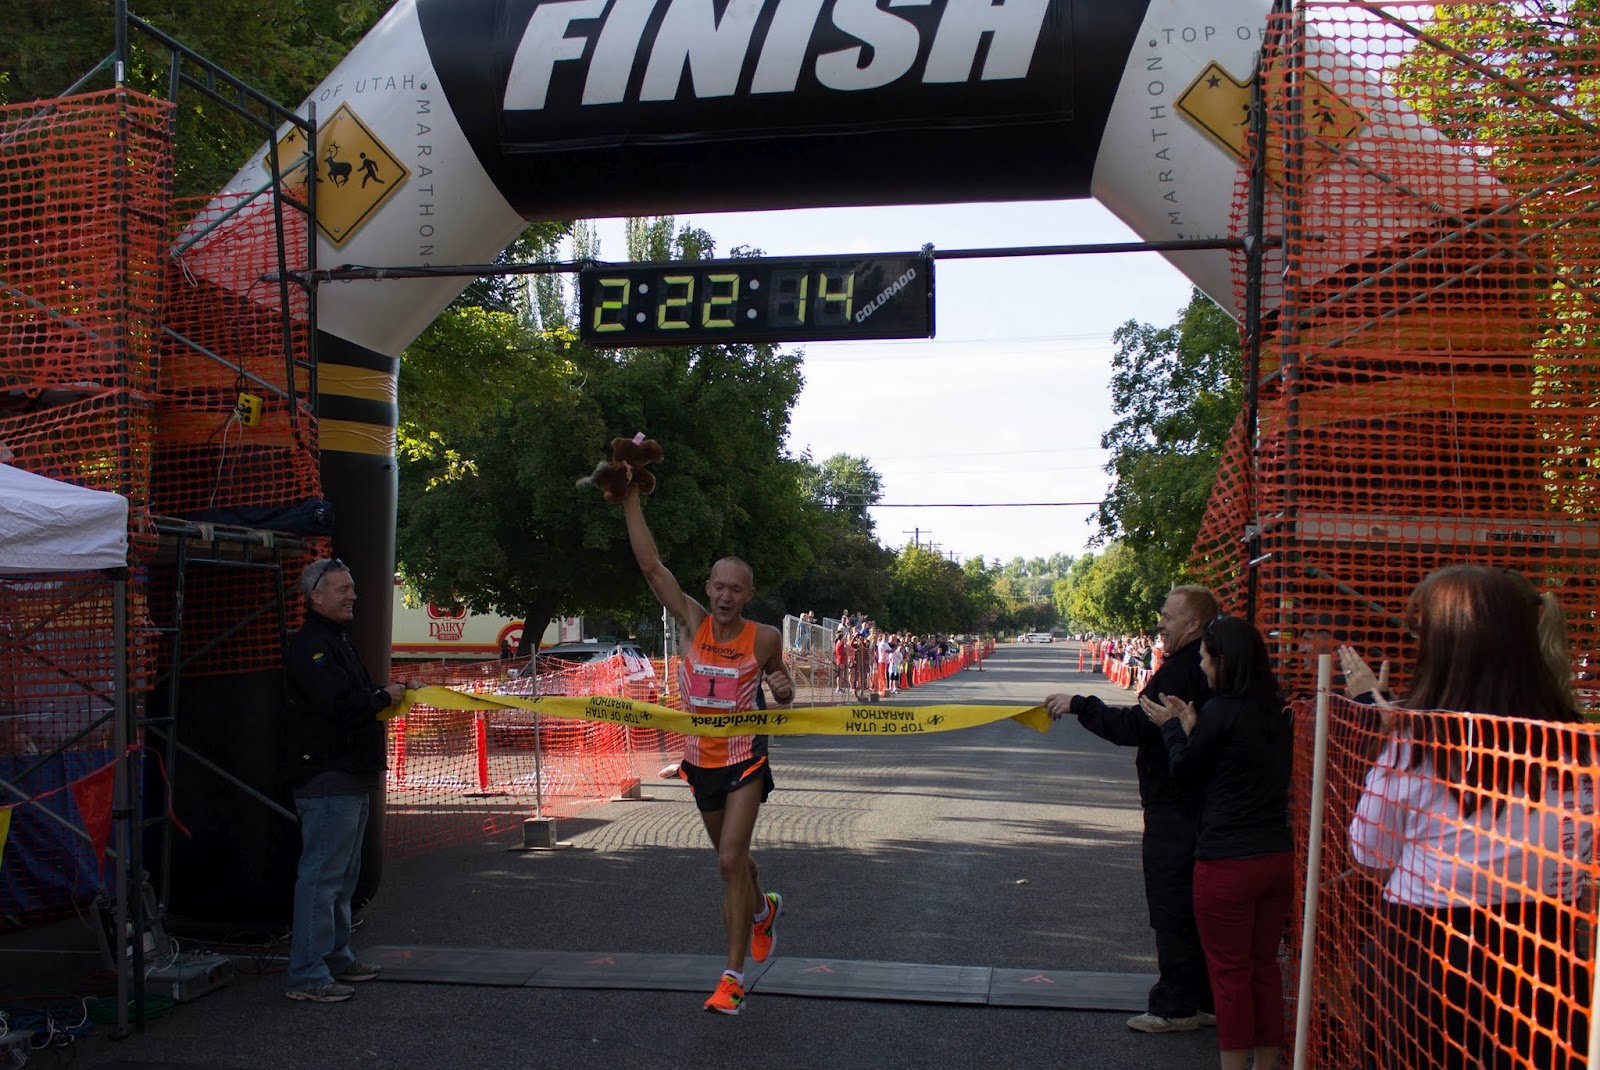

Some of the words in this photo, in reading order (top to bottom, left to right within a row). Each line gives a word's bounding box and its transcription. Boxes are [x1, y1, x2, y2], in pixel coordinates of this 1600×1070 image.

[1161, 26, 1217, 45] TOP
[502, 0, 1050, 111] FINISH
[319, 84, 344, 103] OF
[355, 74, 414, 94] UTAH
[1146, 56, 1183, 226] MARATHON
[416, 99, 434, 257] MARATHON
[592, 271, 855, 333] 2:22:14
[854, 267, 917, 325] COLORADO
[701, 642, 735, 655] saucony
[708, 678, 715, 697] 1
[589, 697, 634, 711] MARATHON
[585, 707, 607, 719] UTAH
[610, 711, 621, 722] OF
[623, 713, 640, 724] TOP
[852, 709, 915, 721] MARATHON
[691, 714, 768, 729] NordicTrack
[845, 721, 877, 732] UTAH
[880, 722, 897, 733] OF
[900, 722, 925, 733] TOP
